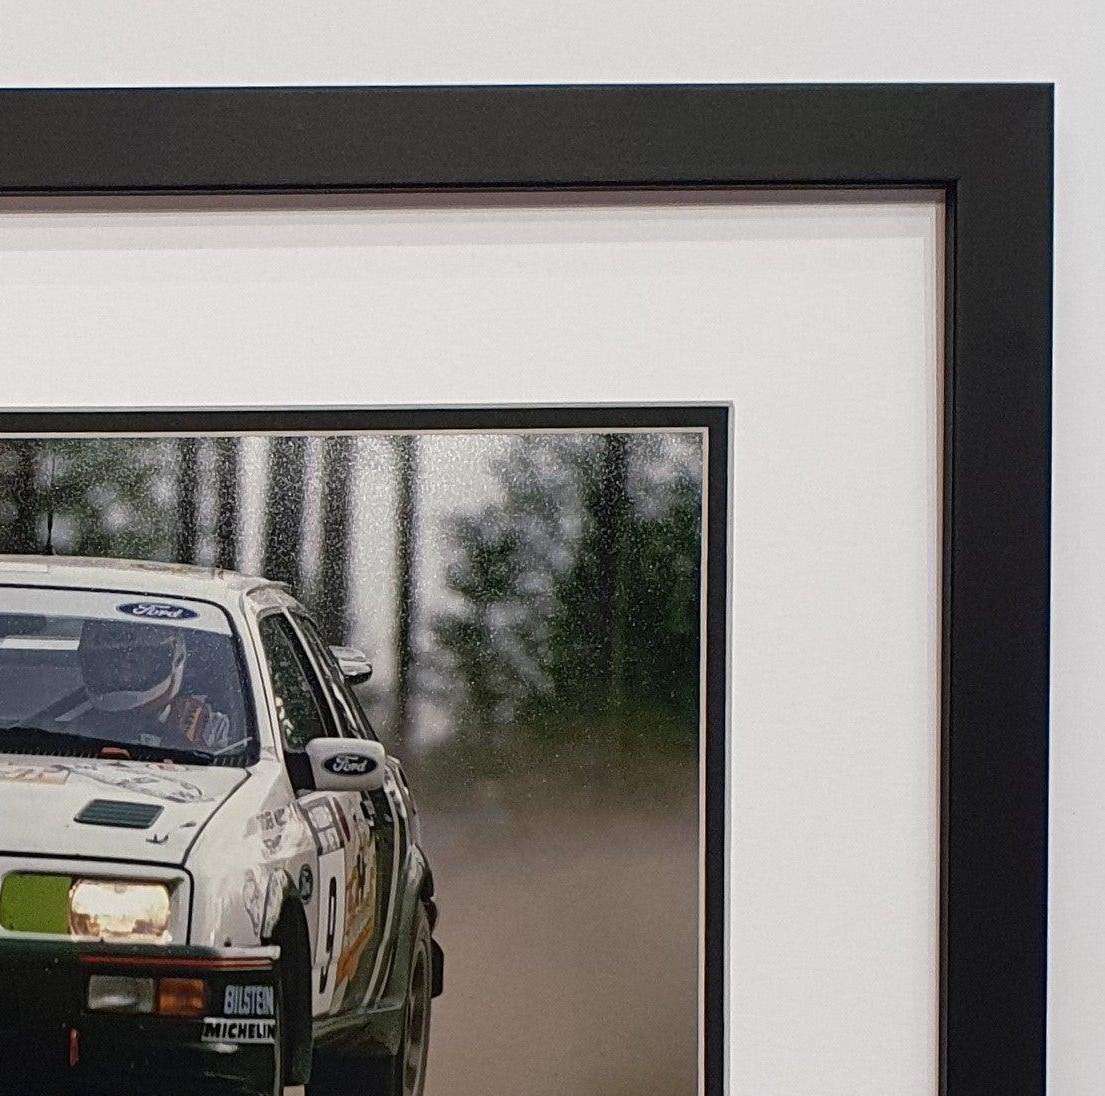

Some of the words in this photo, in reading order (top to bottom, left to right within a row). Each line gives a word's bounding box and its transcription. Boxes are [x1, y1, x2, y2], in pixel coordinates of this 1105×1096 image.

[132, 604, 184, 618] Ford
[332, 755, 368, 772] Ford
[204, 1022, 276, 1039] MICHELIN
